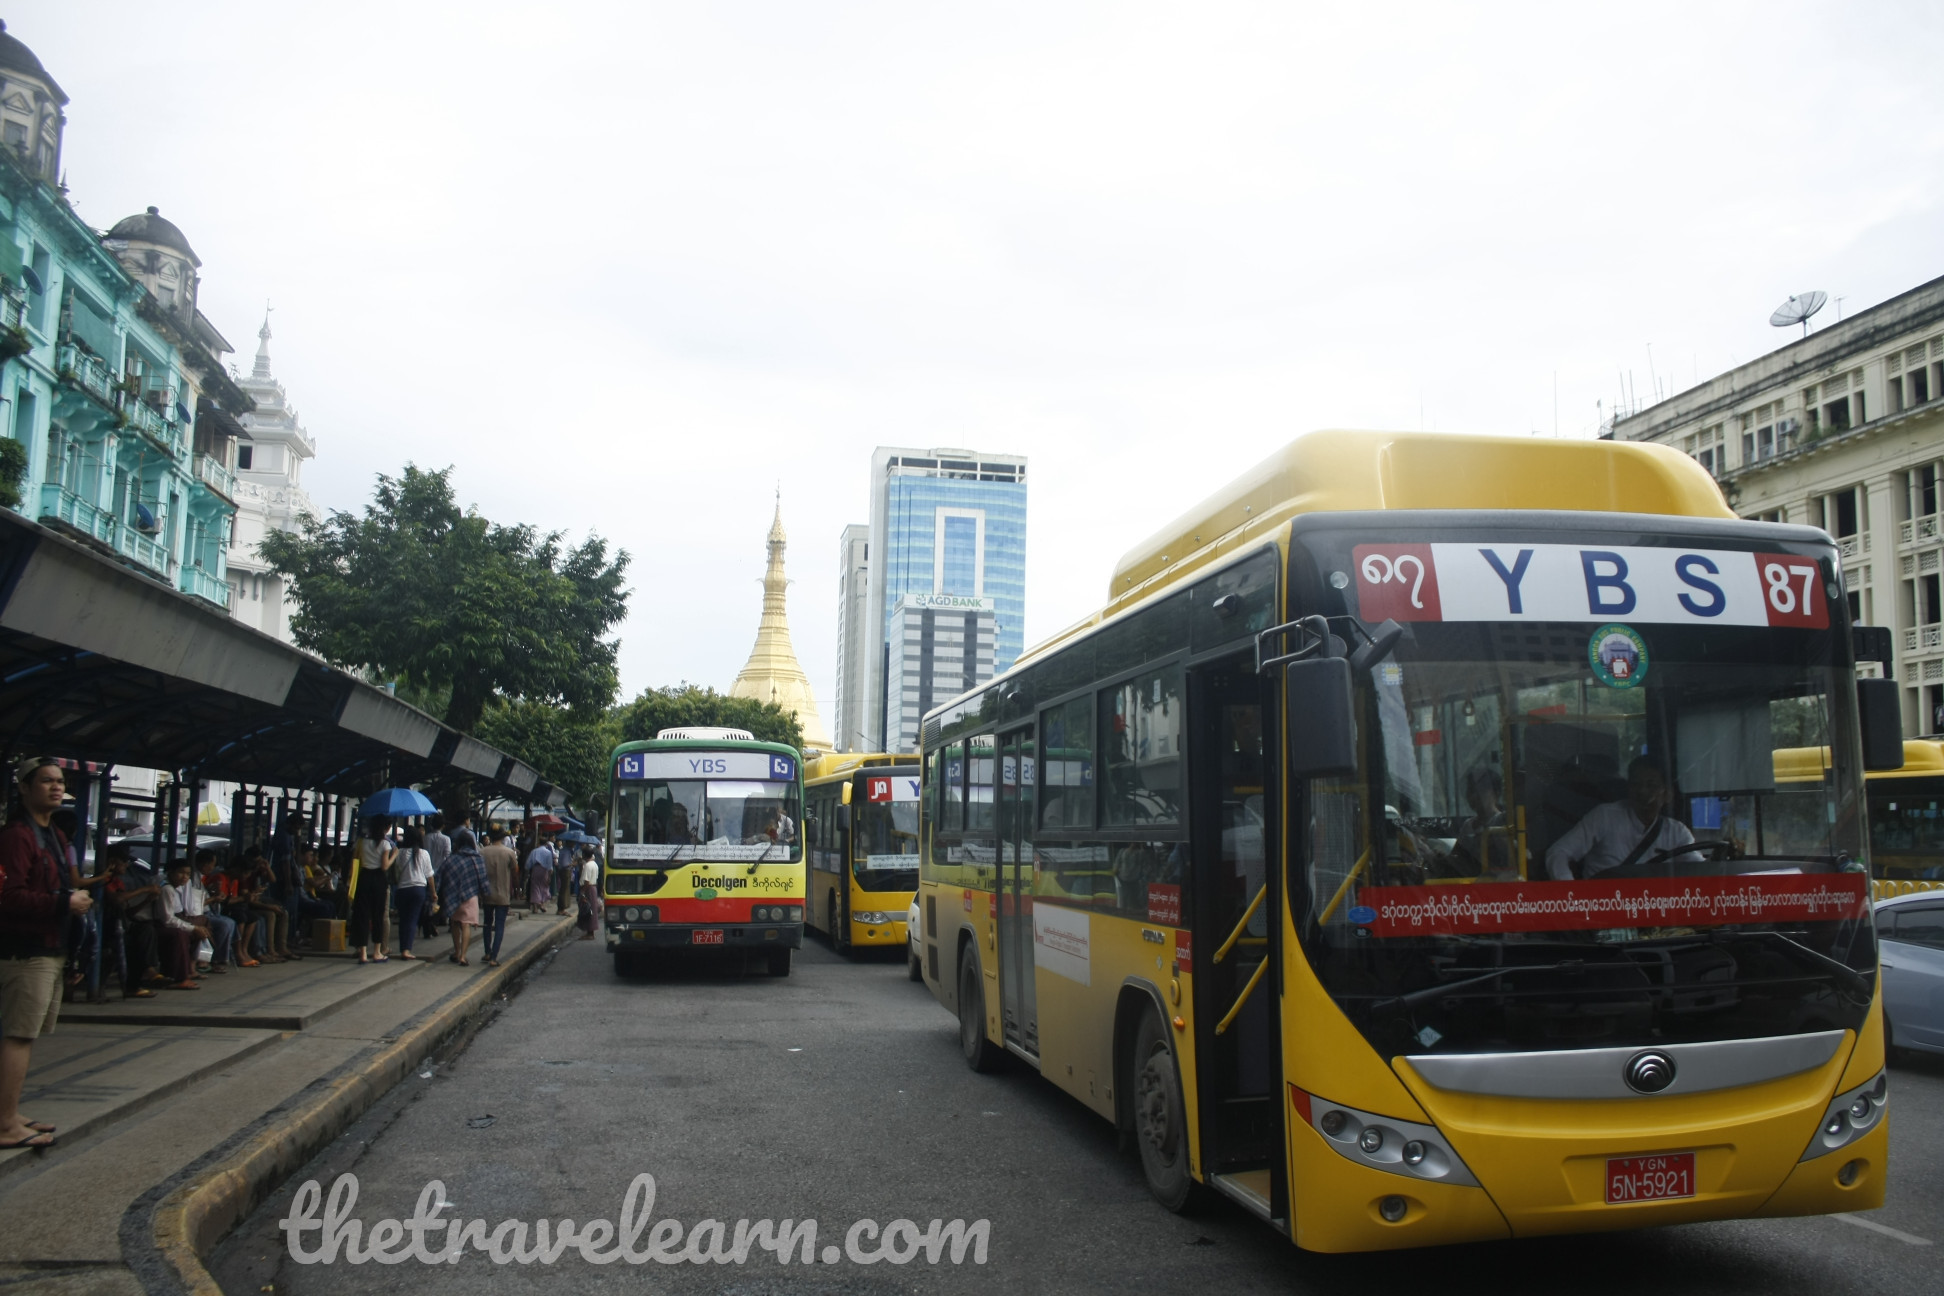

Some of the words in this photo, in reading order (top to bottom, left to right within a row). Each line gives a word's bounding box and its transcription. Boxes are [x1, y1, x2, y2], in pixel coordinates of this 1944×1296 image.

[1361, 554, 1425, 609] ၈၇
[1763, 563, 1815, 616] 87
[689, 759, 726, 773] YBS
[692, 875, 747, 891] Decolgen
[1638, 1158, 1667, 1171] YGN
[1612, 1169, 1688, 1200] 5N-5921
